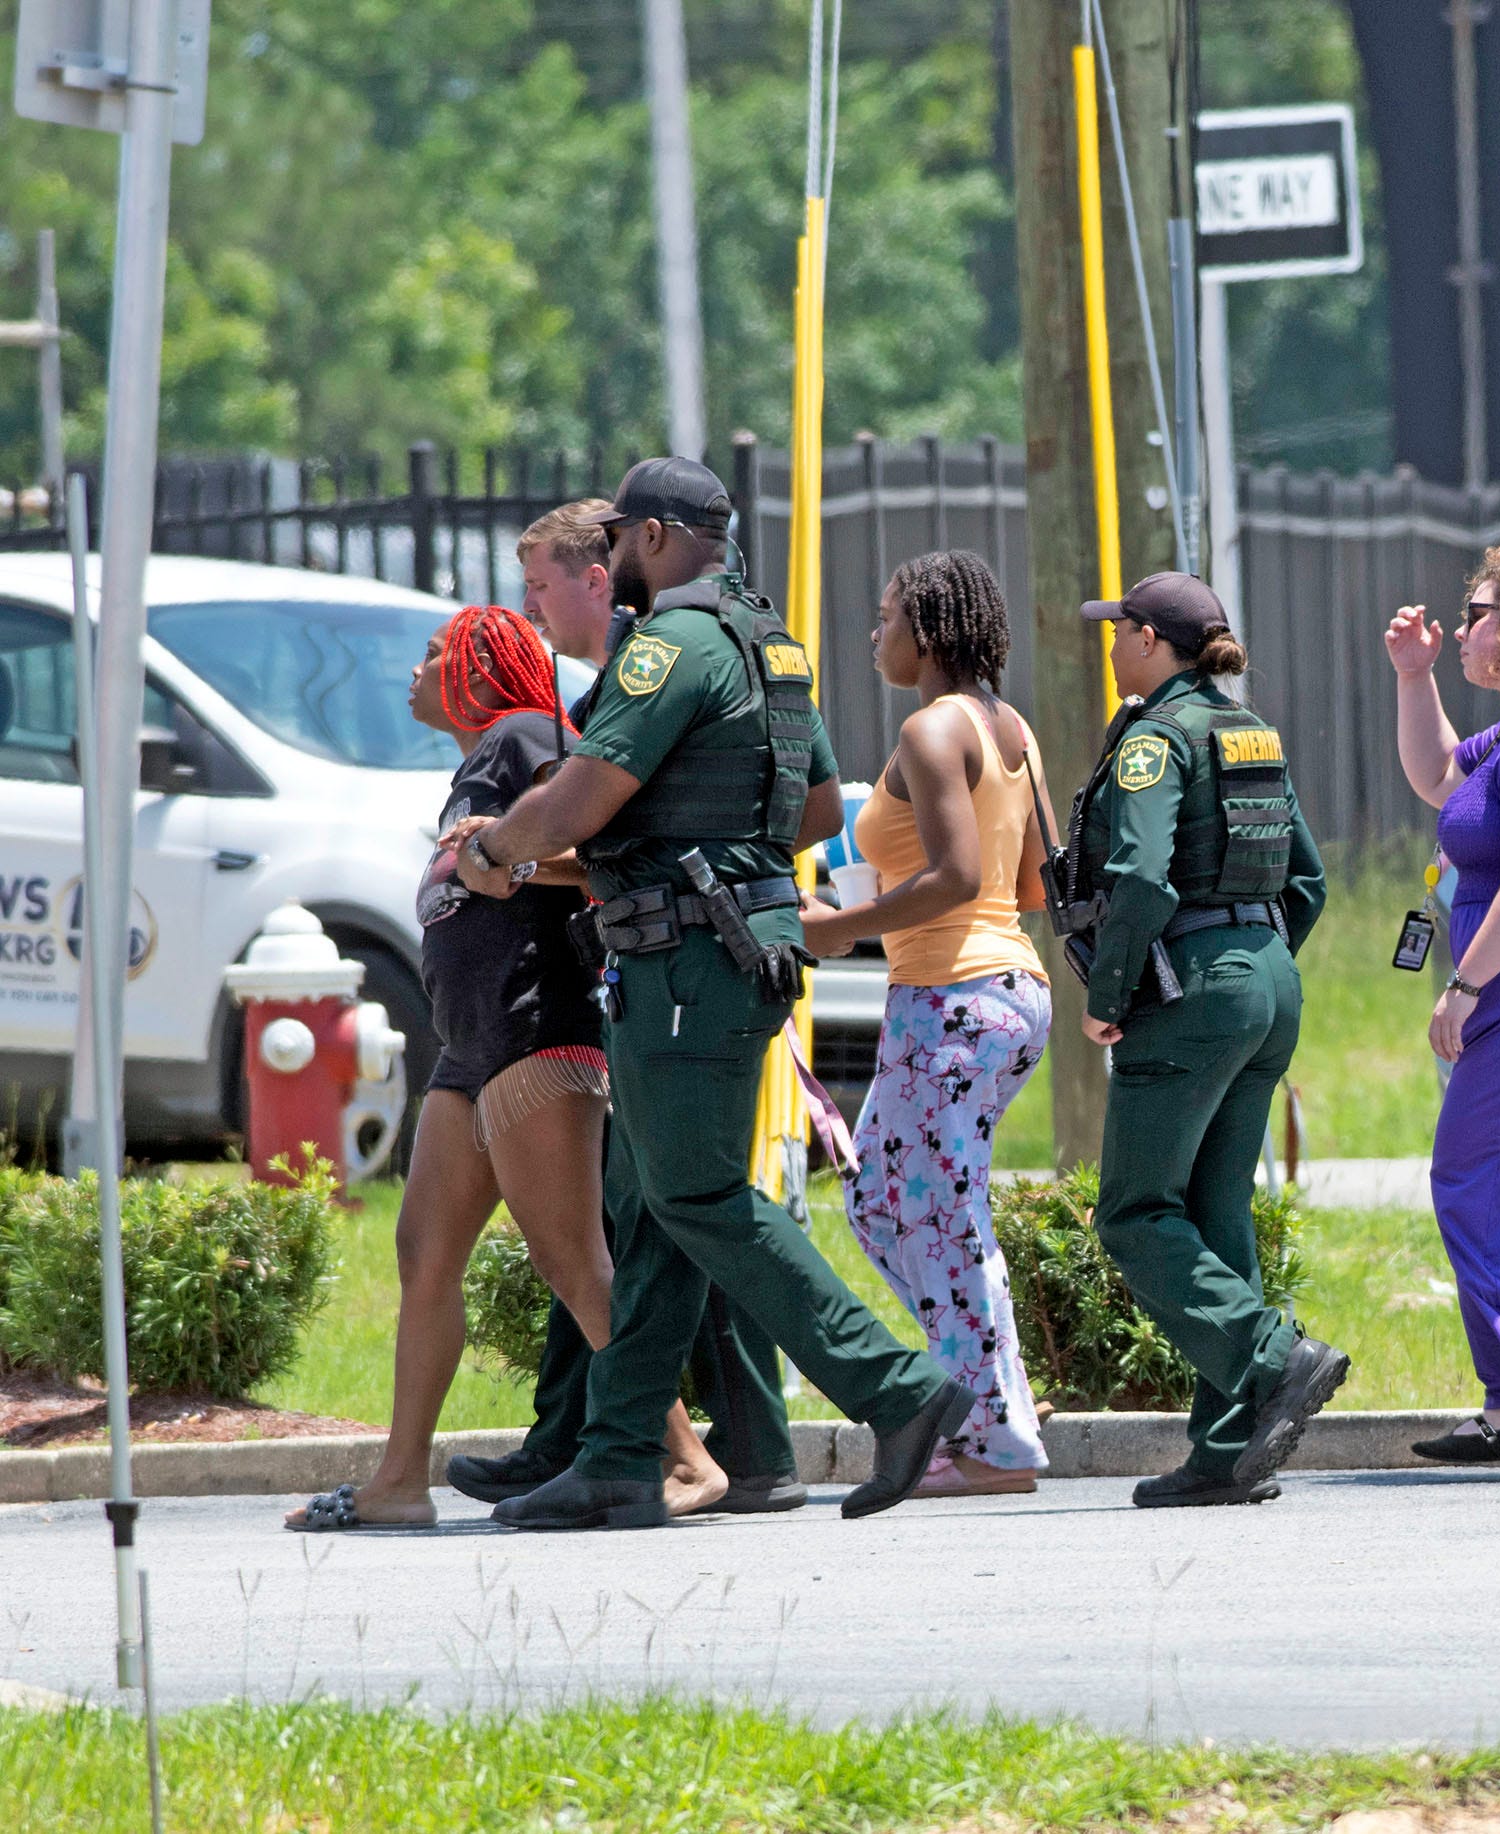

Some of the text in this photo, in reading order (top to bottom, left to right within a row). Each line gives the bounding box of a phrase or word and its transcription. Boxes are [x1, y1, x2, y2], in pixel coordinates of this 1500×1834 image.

[1206, 170, 1314, 219] NE WAY
[0, 875, 50, 925] WS
[0, 932, 57, 967] KRG
